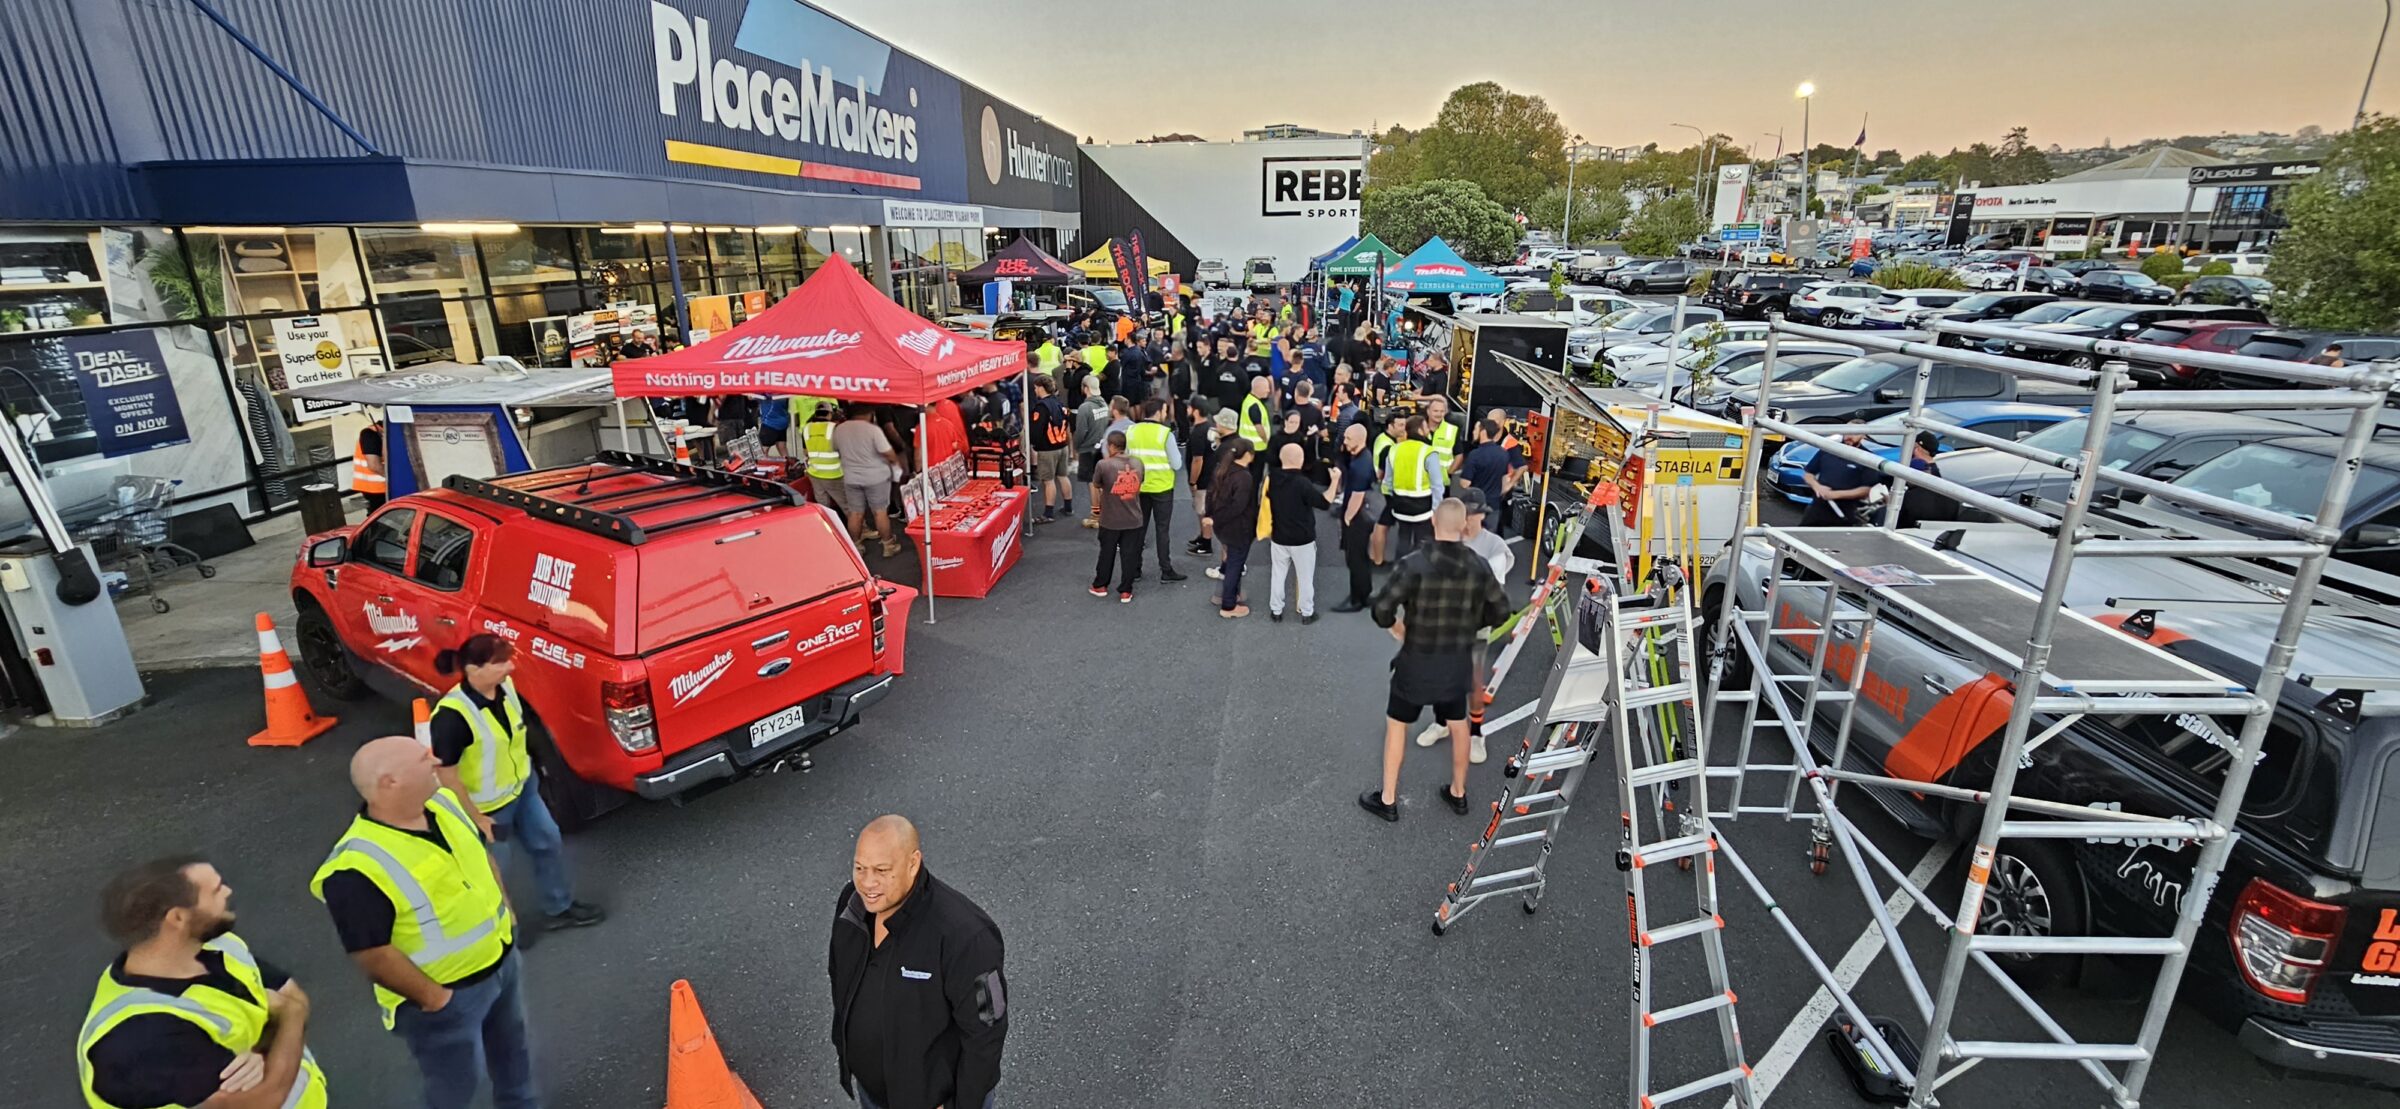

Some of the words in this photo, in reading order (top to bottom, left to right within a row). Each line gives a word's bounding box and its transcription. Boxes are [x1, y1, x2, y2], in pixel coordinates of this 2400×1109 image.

[651, 1, 918, 163] PlaceMakers
[1006, 127, 1073, 189] Hunterhome
[2207, 167, 2258, 178] LEXUS
[890, 207, 915, 220] WELCOME
[1307, 208, 1357, 217] SPORT
[995, 267, 1039, 275] ROCK
[998, 258, 1028, 269] THE
[1414, 267, 1466, 276] makita
[1121, 268, 1136, 301] ROCK
[287, 331, 306, 341] Use
[308, 330, 329, 341] your
[723, 329, 862, 359] Milwaukee
[74, 349, 139, 371] DEAL
[285, 349, 342, 365] SuperGold
[89, 362, 156, 388] DASH
[296, 374, 319, 383] Card
[320, 371, 343, 380] Here
[645, 372, 715, 389] Nothing
[720, 371, 750, 387] but
[754, 371, 825, 390] HEAVY
[936, 371, 967, 387] Nothing
[966, 363, 979, 377] but
[978, 356, 1002, 373] HEAVY
[107, 393, 155, 406] EXCLUSIVE
[114, 401, 153, 412] MONTHLY
[120, 408, 155, 419] OFFERS
[115, 423, 133, 434] ON
[137, 416, 168, 431] NOW
[1655, 461, 1712, 473] STABILA
[532, 552, 554, 582] JOB
[551, 558, 576, 590] SITE
[362, 600, 419, 635] Milwaukee
[531, 637, 572, 664] FUEL
[667, 650, 733, 699] Milwaukee
[751, 710, 802, 741] PFY234
[1633, 947, 1641, 983] LEVELER
